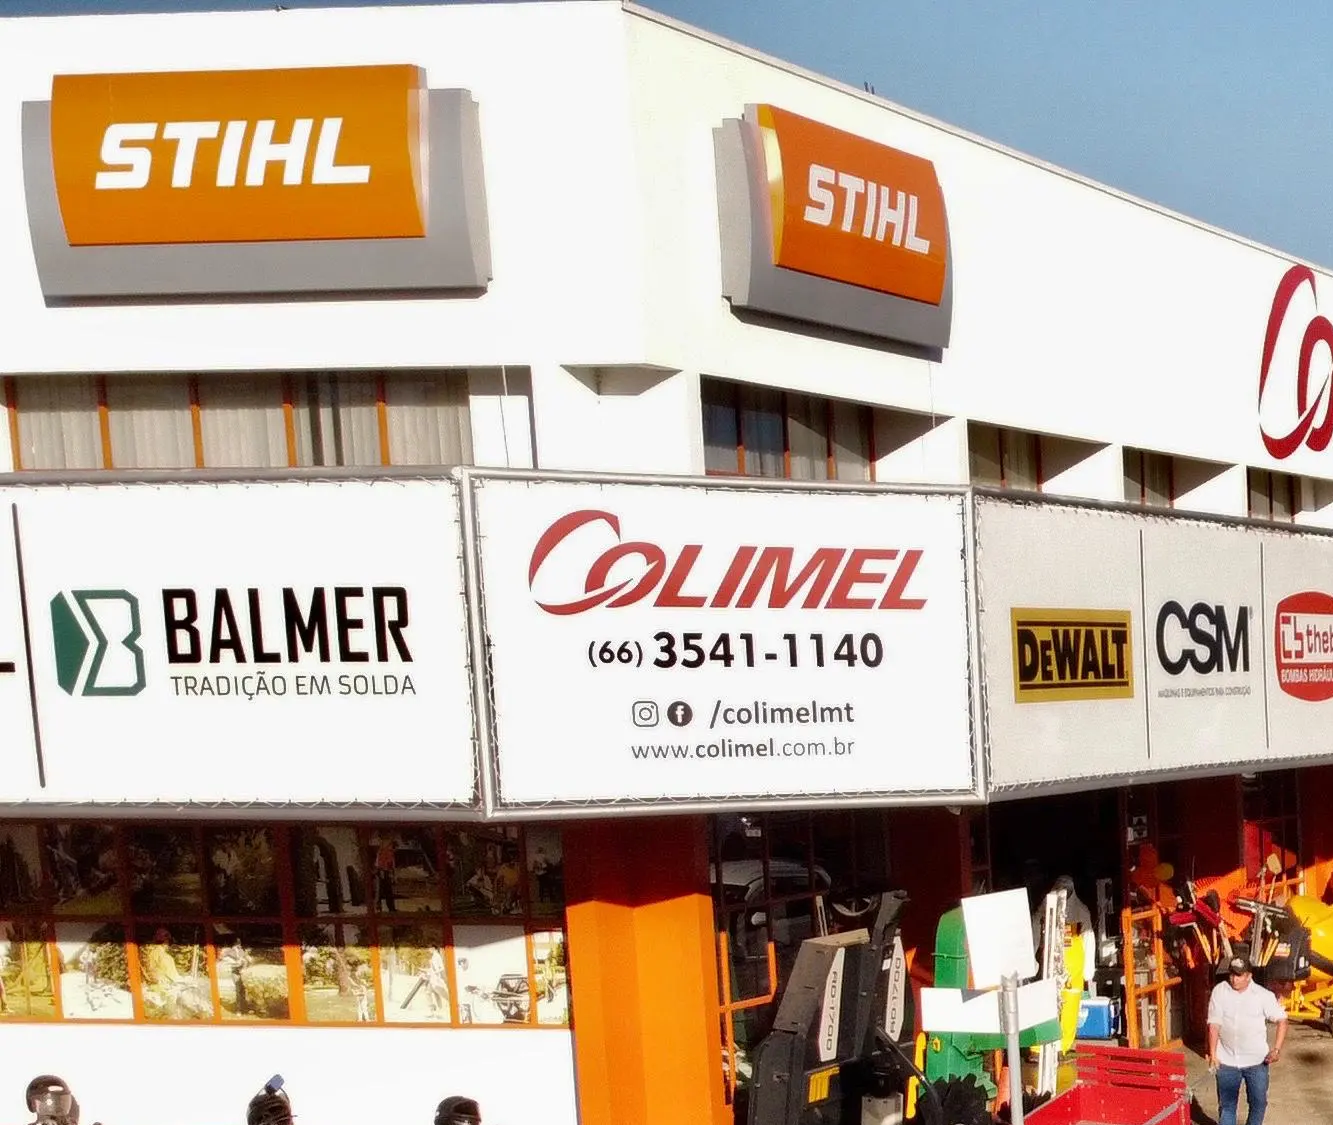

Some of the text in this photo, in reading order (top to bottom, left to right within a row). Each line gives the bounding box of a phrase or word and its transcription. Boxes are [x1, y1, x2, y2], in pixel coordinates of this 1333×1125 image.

[94, 117, 371, 191] STIHL
[803, 163, 931, 256] STIHL
[528, 509, 929, 616] COLIMEL
[161, 586, 413, 664] BALMER
[588, 632, 884, 669] (66) 3541-1140
[1156, 600, 1250, 676] CSM
[170, 671, 417, 701] TRADIÇÃO EM SOLDA
[1281, 669, 1308, 683] BOMBAS
[709, 700, 855, 730] /colimelmt
[631, 738, 856, 760] www.colimel.com.br
